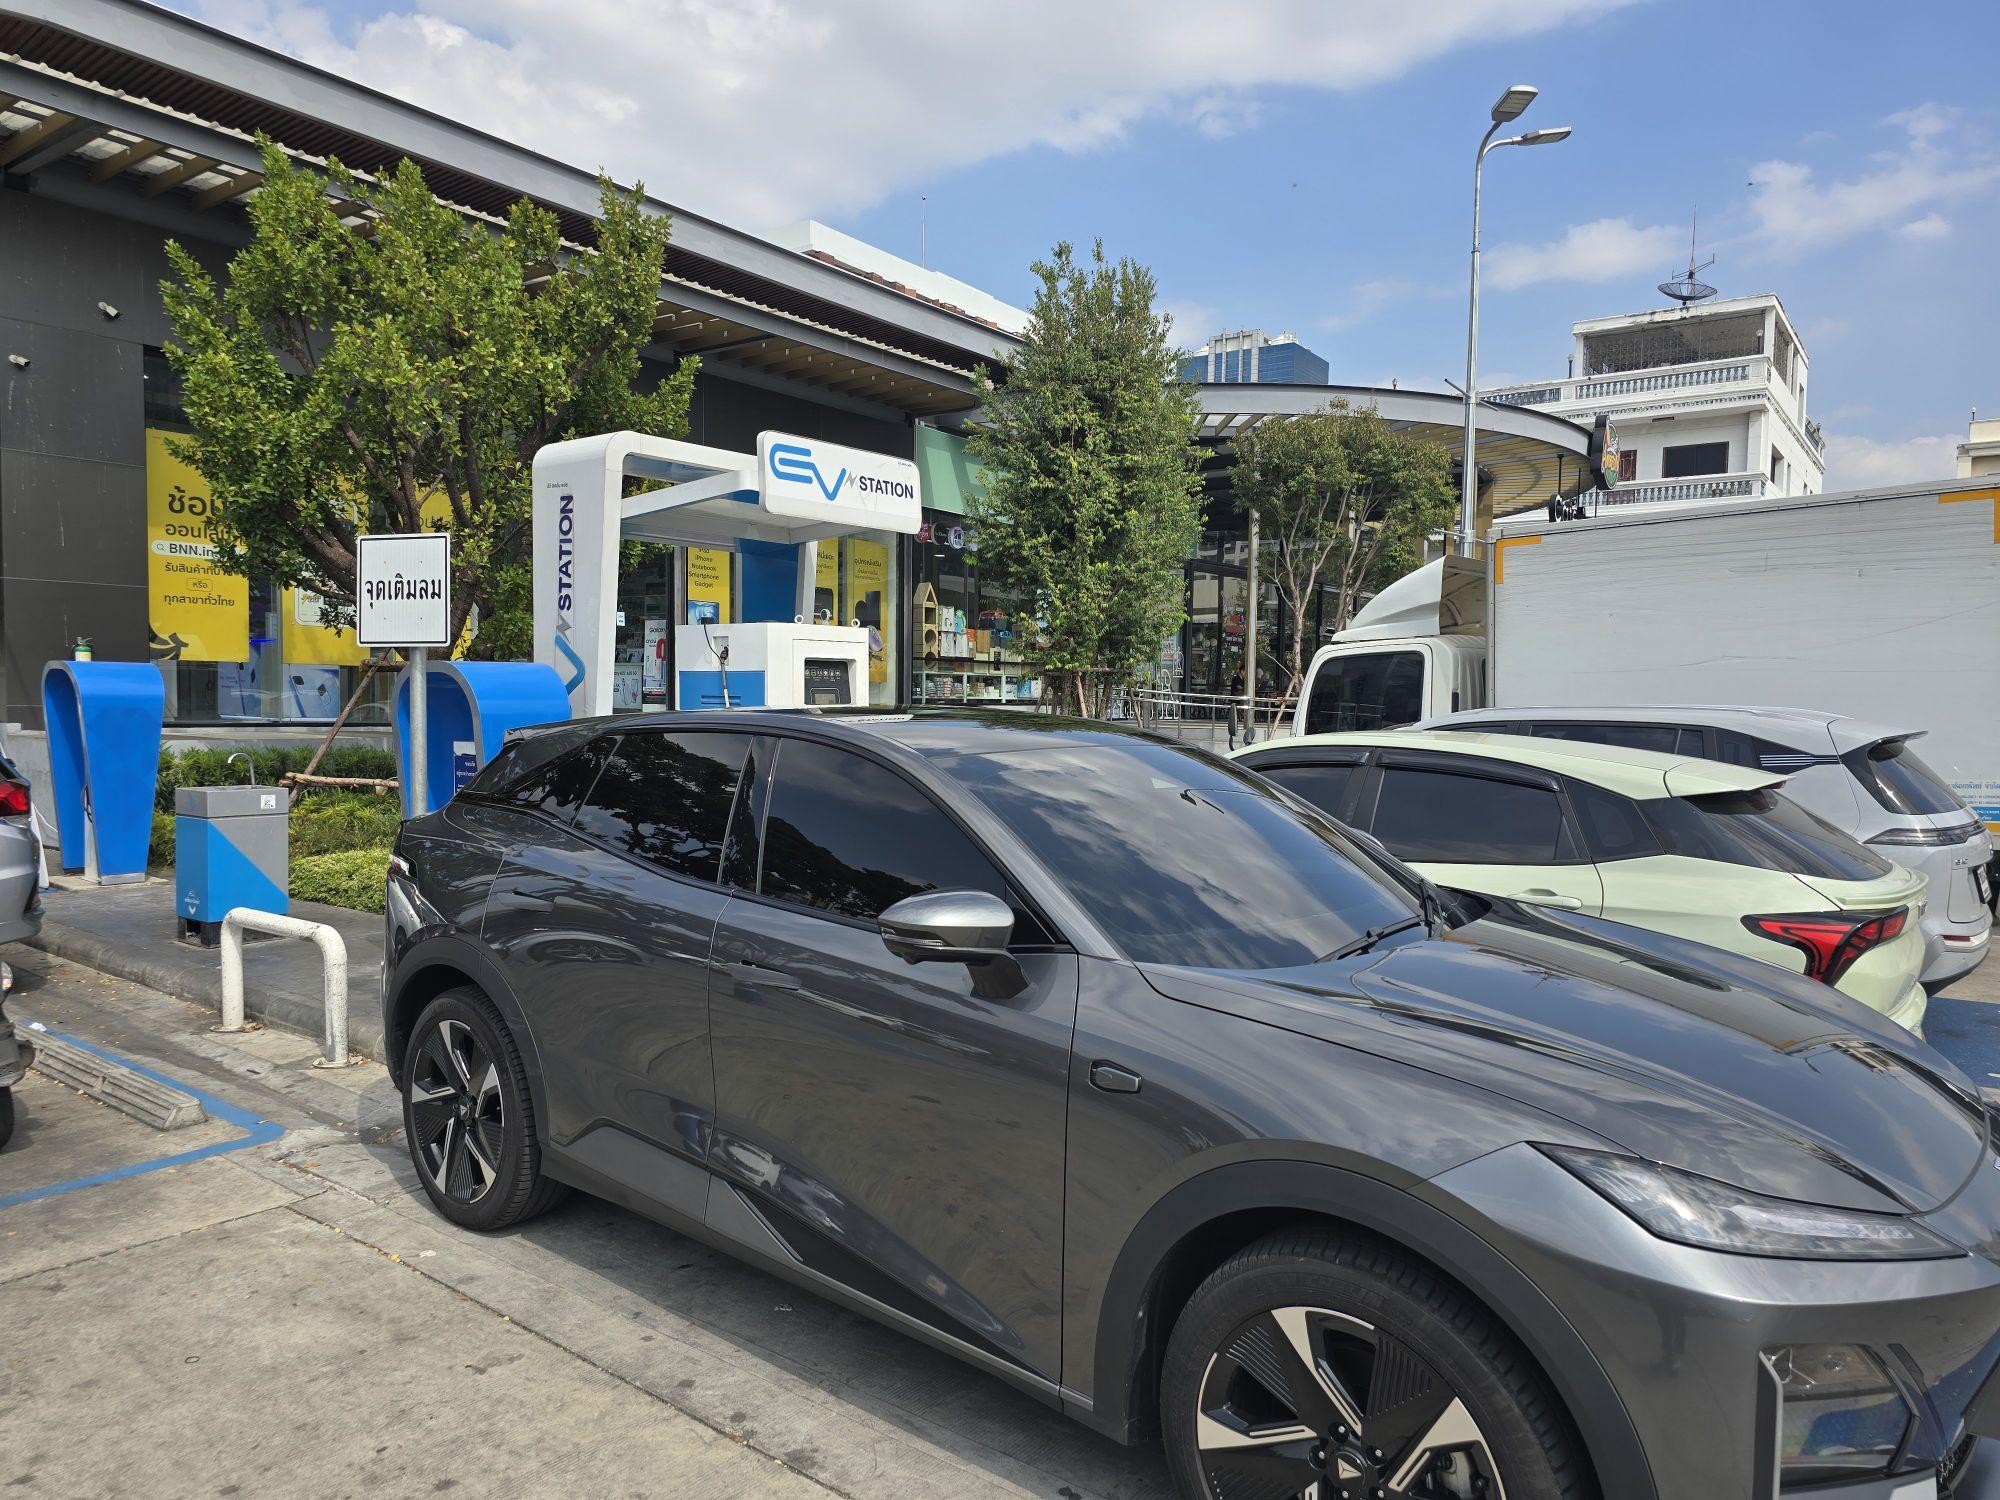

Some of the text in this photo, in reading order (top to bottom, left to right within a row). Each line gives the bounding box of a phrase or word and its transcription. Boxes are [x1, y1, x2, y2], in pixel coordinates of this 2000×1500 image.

[769, 443, 914, 501] EV STATION
[557, 494, 574, 611] STATION
[164, 593, 235, 607] ทุกสาขาทั่วไทย
[365, 572, 442, 610] จุดเติมลม
